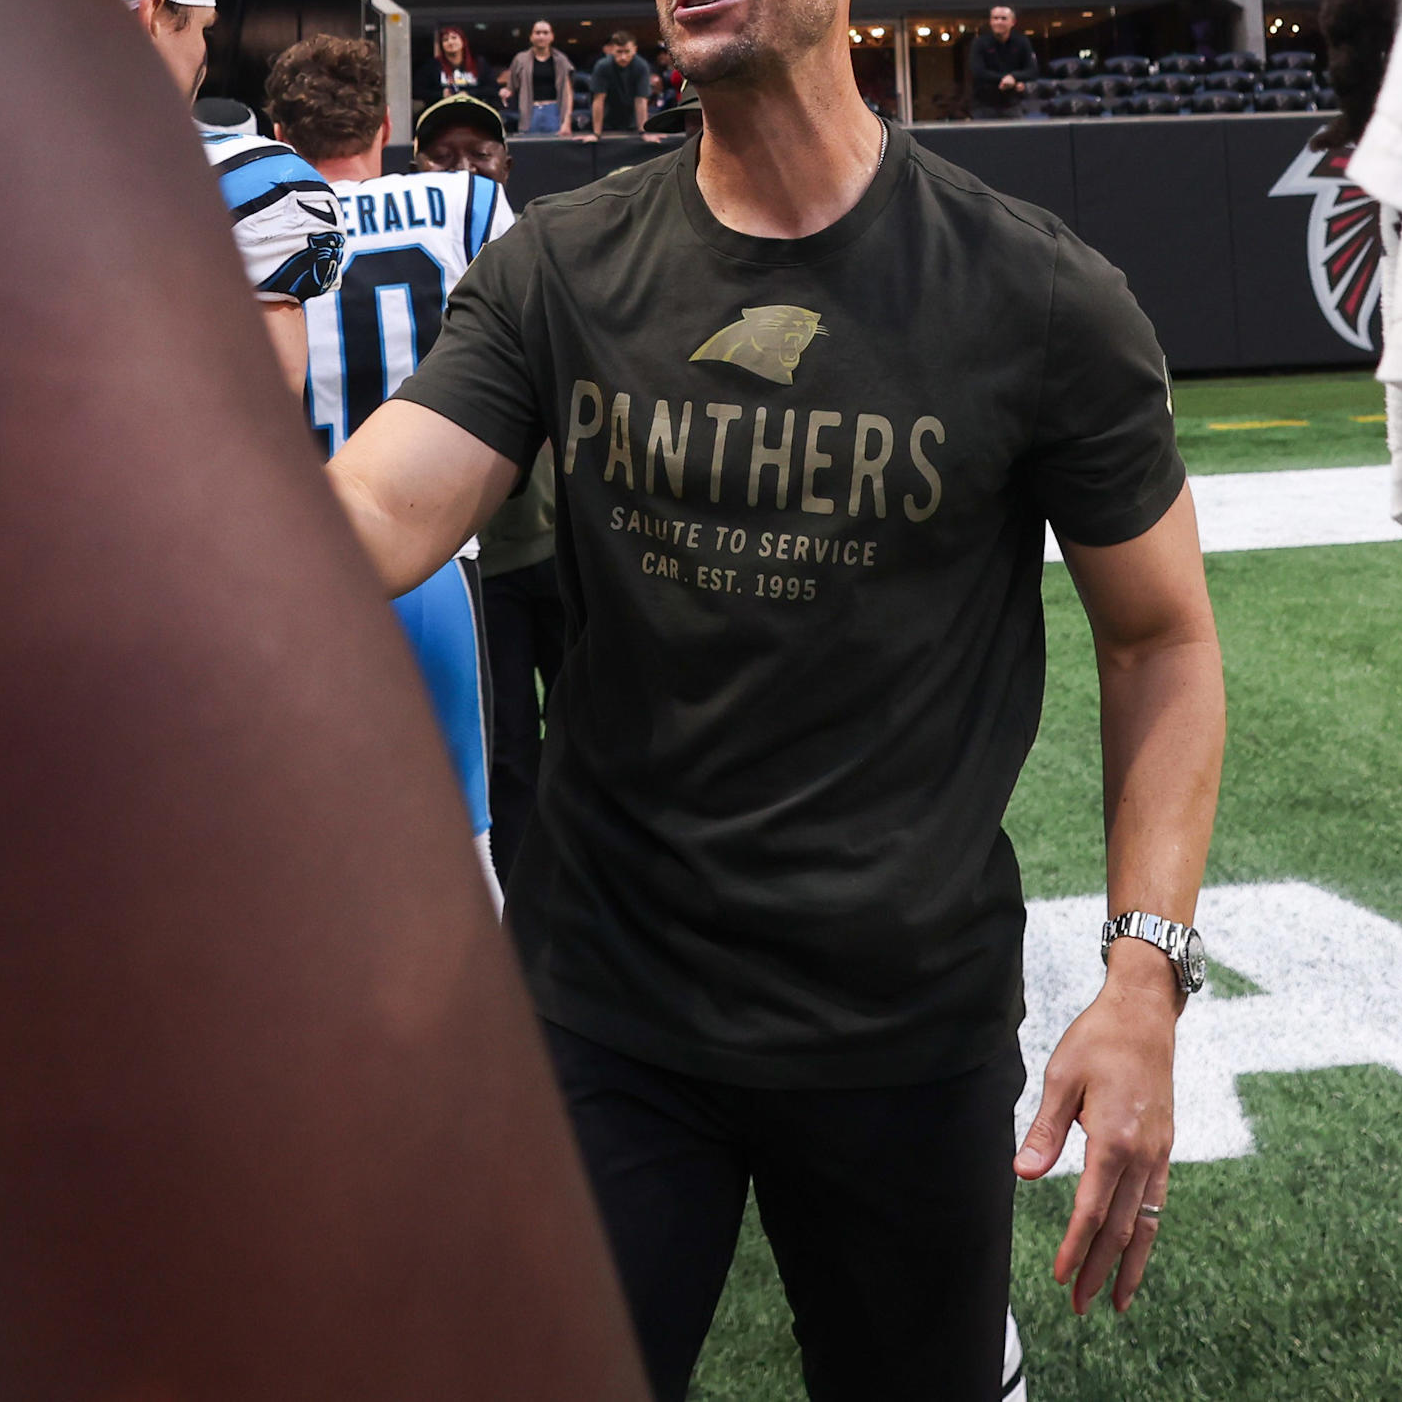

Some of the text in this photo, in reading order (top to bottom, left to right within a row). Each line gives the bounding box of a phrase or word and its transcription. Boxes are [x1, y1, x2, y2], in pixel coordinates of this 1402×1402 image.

[338, 185, 447, 238] ERALD
[564, 379, 946, 523] PANTHERS
[609, 506, 878, 567] SALUTE TO SERVICE
[641, 552, 817, 601] CAR. EST. 1995
